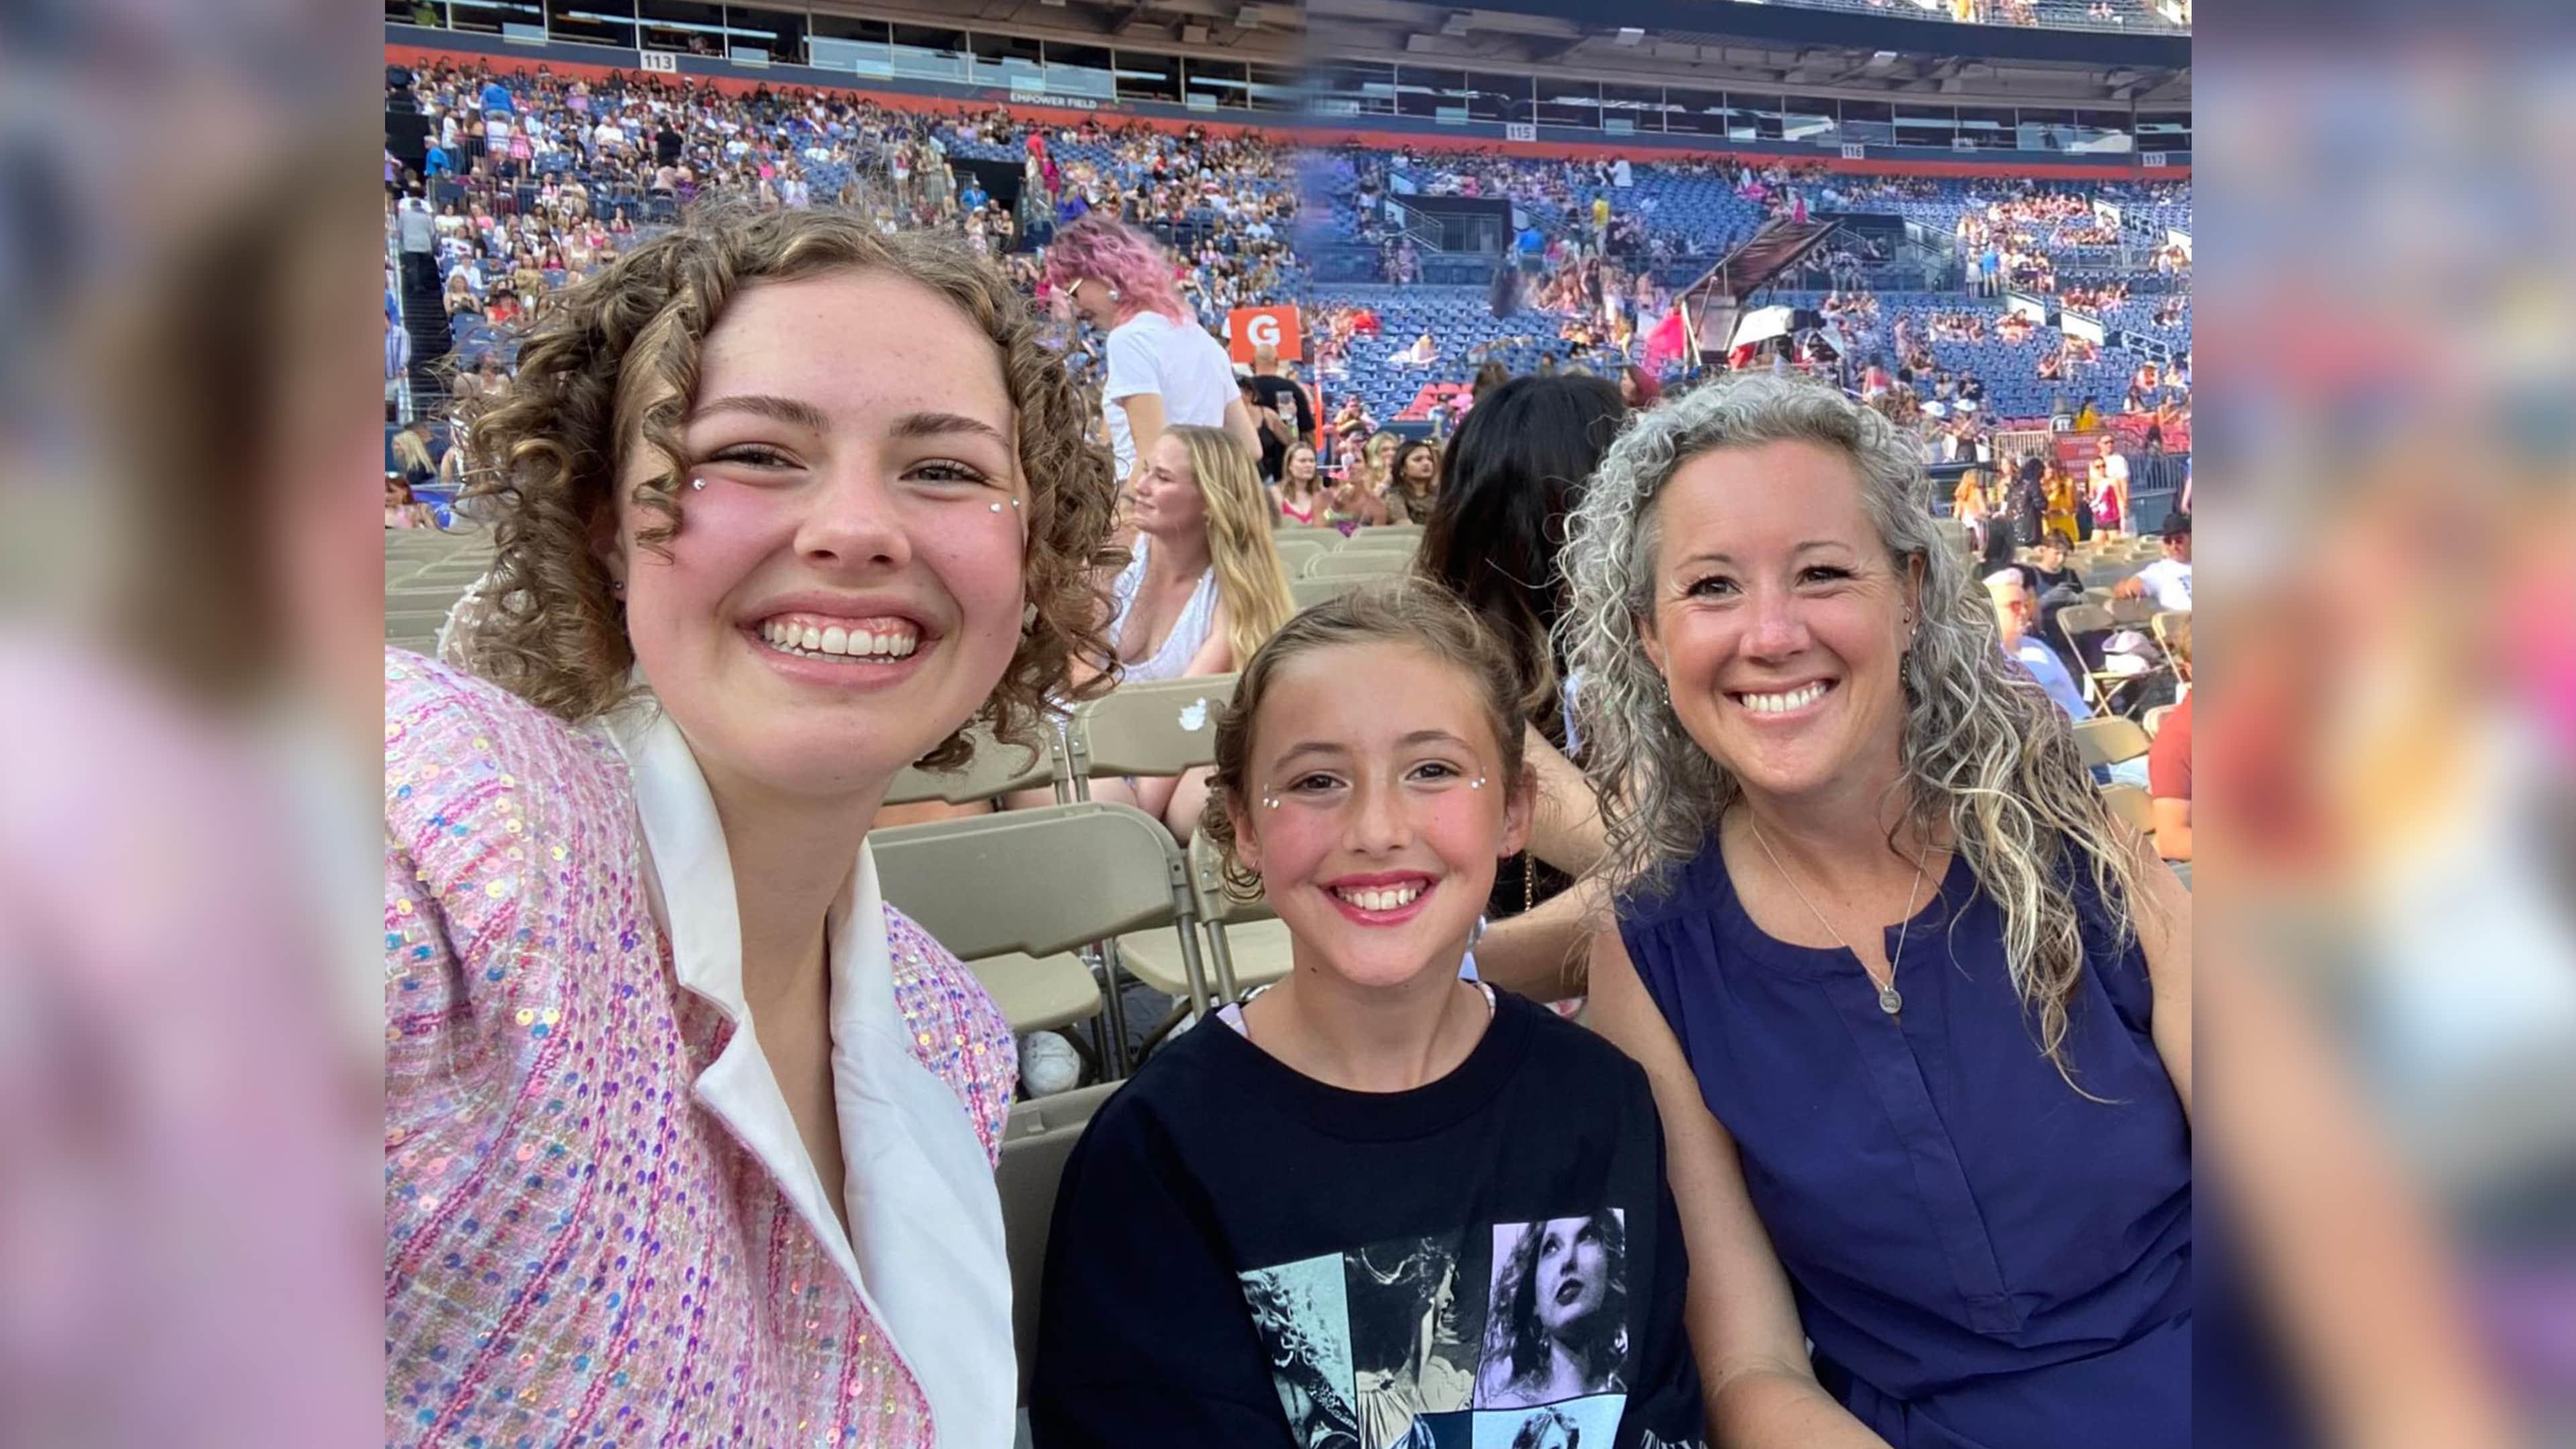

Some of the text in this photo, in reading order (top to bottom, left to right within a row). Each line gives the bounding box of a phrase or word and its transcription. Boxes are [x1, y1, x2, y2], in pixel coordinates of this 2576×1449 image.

[644, 54, 672, 69] 113
[1010, 93, 1097, 109] EMPOWER FIELD
[1511, 126, 1531, 139] 115
[1845, 146, 1862, 157] 116
[1248, 315, 1280, 346] G
